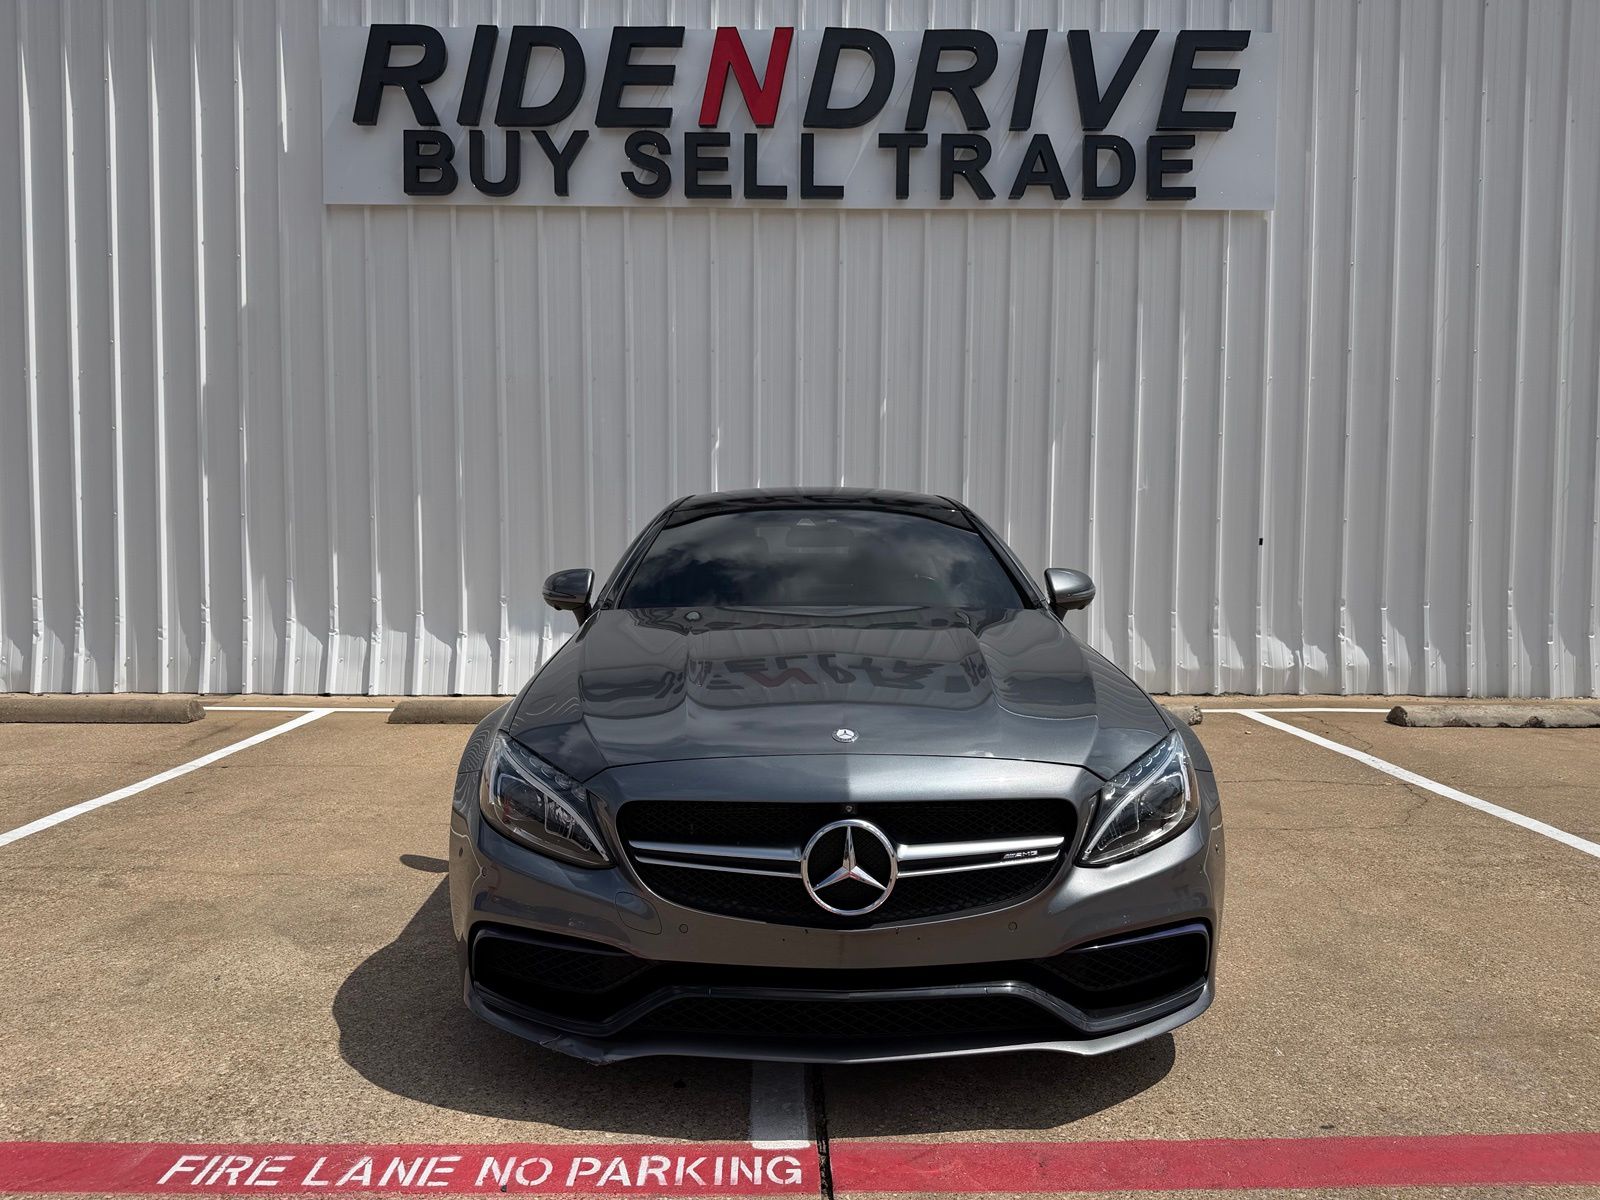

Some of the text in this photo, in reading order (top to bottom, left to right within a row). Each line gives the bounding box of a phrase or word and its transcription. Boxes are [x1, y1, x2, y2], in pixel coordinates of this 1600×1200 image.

[403, 129, 1197, 202] BUY SELL TRADE
[1012, 849, 1038, 859] AMG
[156, 1155, 802, 1187] FIRE LANE NO PARKING
